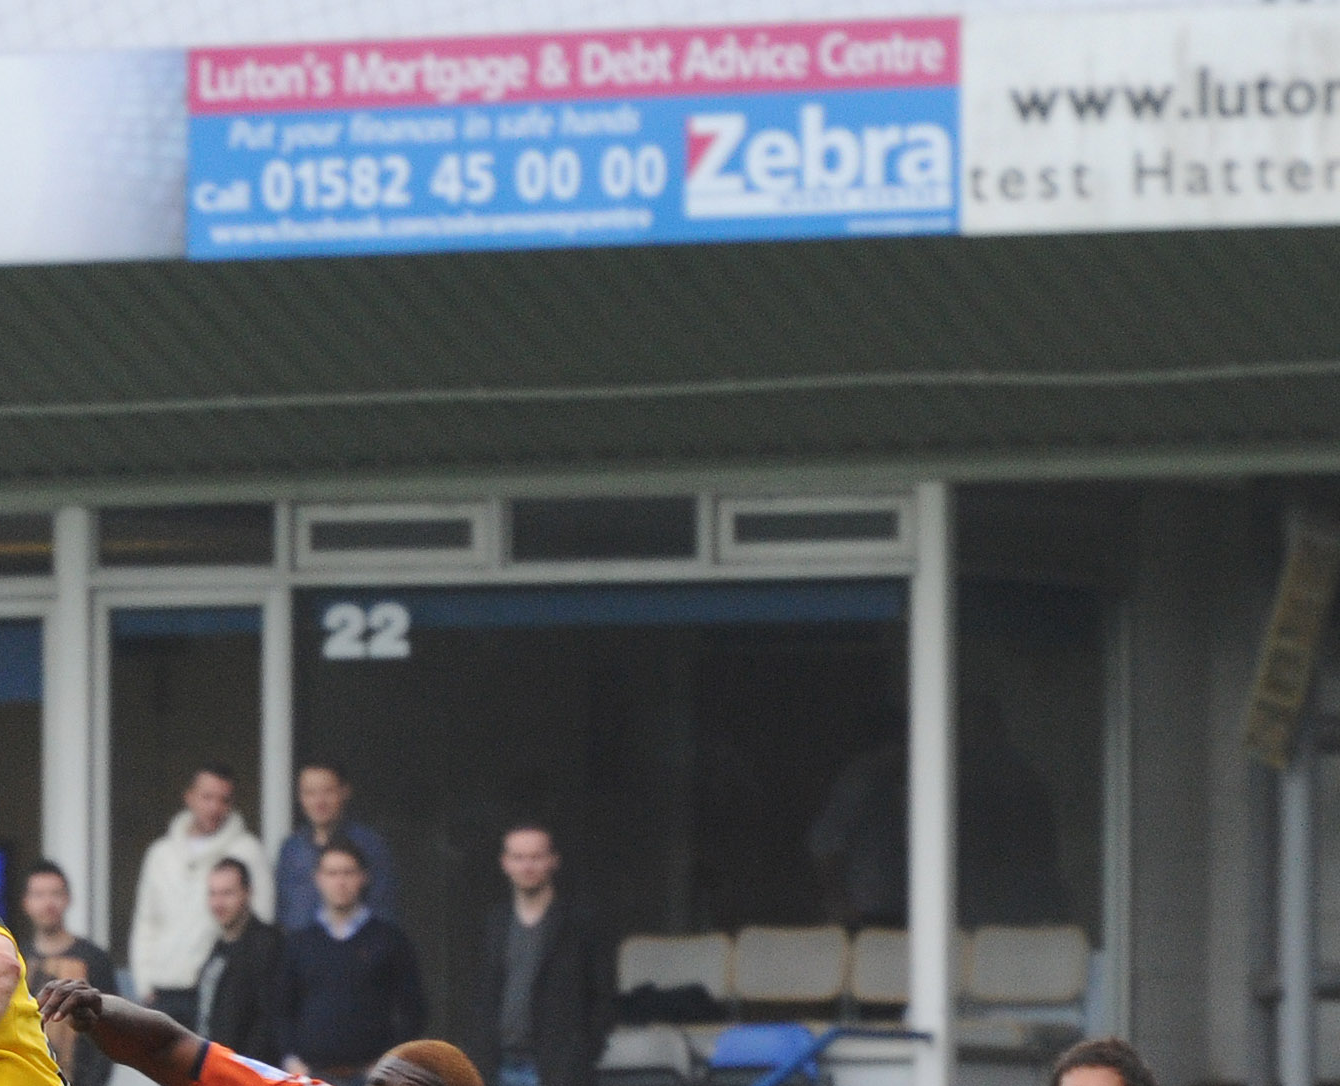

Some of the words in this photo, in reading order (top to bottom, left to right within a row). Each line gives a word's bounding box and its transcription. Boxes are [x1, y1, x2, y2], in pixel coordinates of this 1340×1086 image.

[197, 54, 333, 101] Luton's
[342, 50, 528, 102] Mortgage
[538, 43, 570, 87] &
[580, 40, 673, 86] Debt
[682, 33, 809, 80] Advice
[818, 31, 945, 76] Centre
[261, 154, 411, 213] 01582
[429, 151, 496, 205] 45
[515, 147, 583, 202] 00
[601, 144, 667, 199] 00
[687, 102, 954, 193] Zebra
[321, 602, 411, 660] 22
